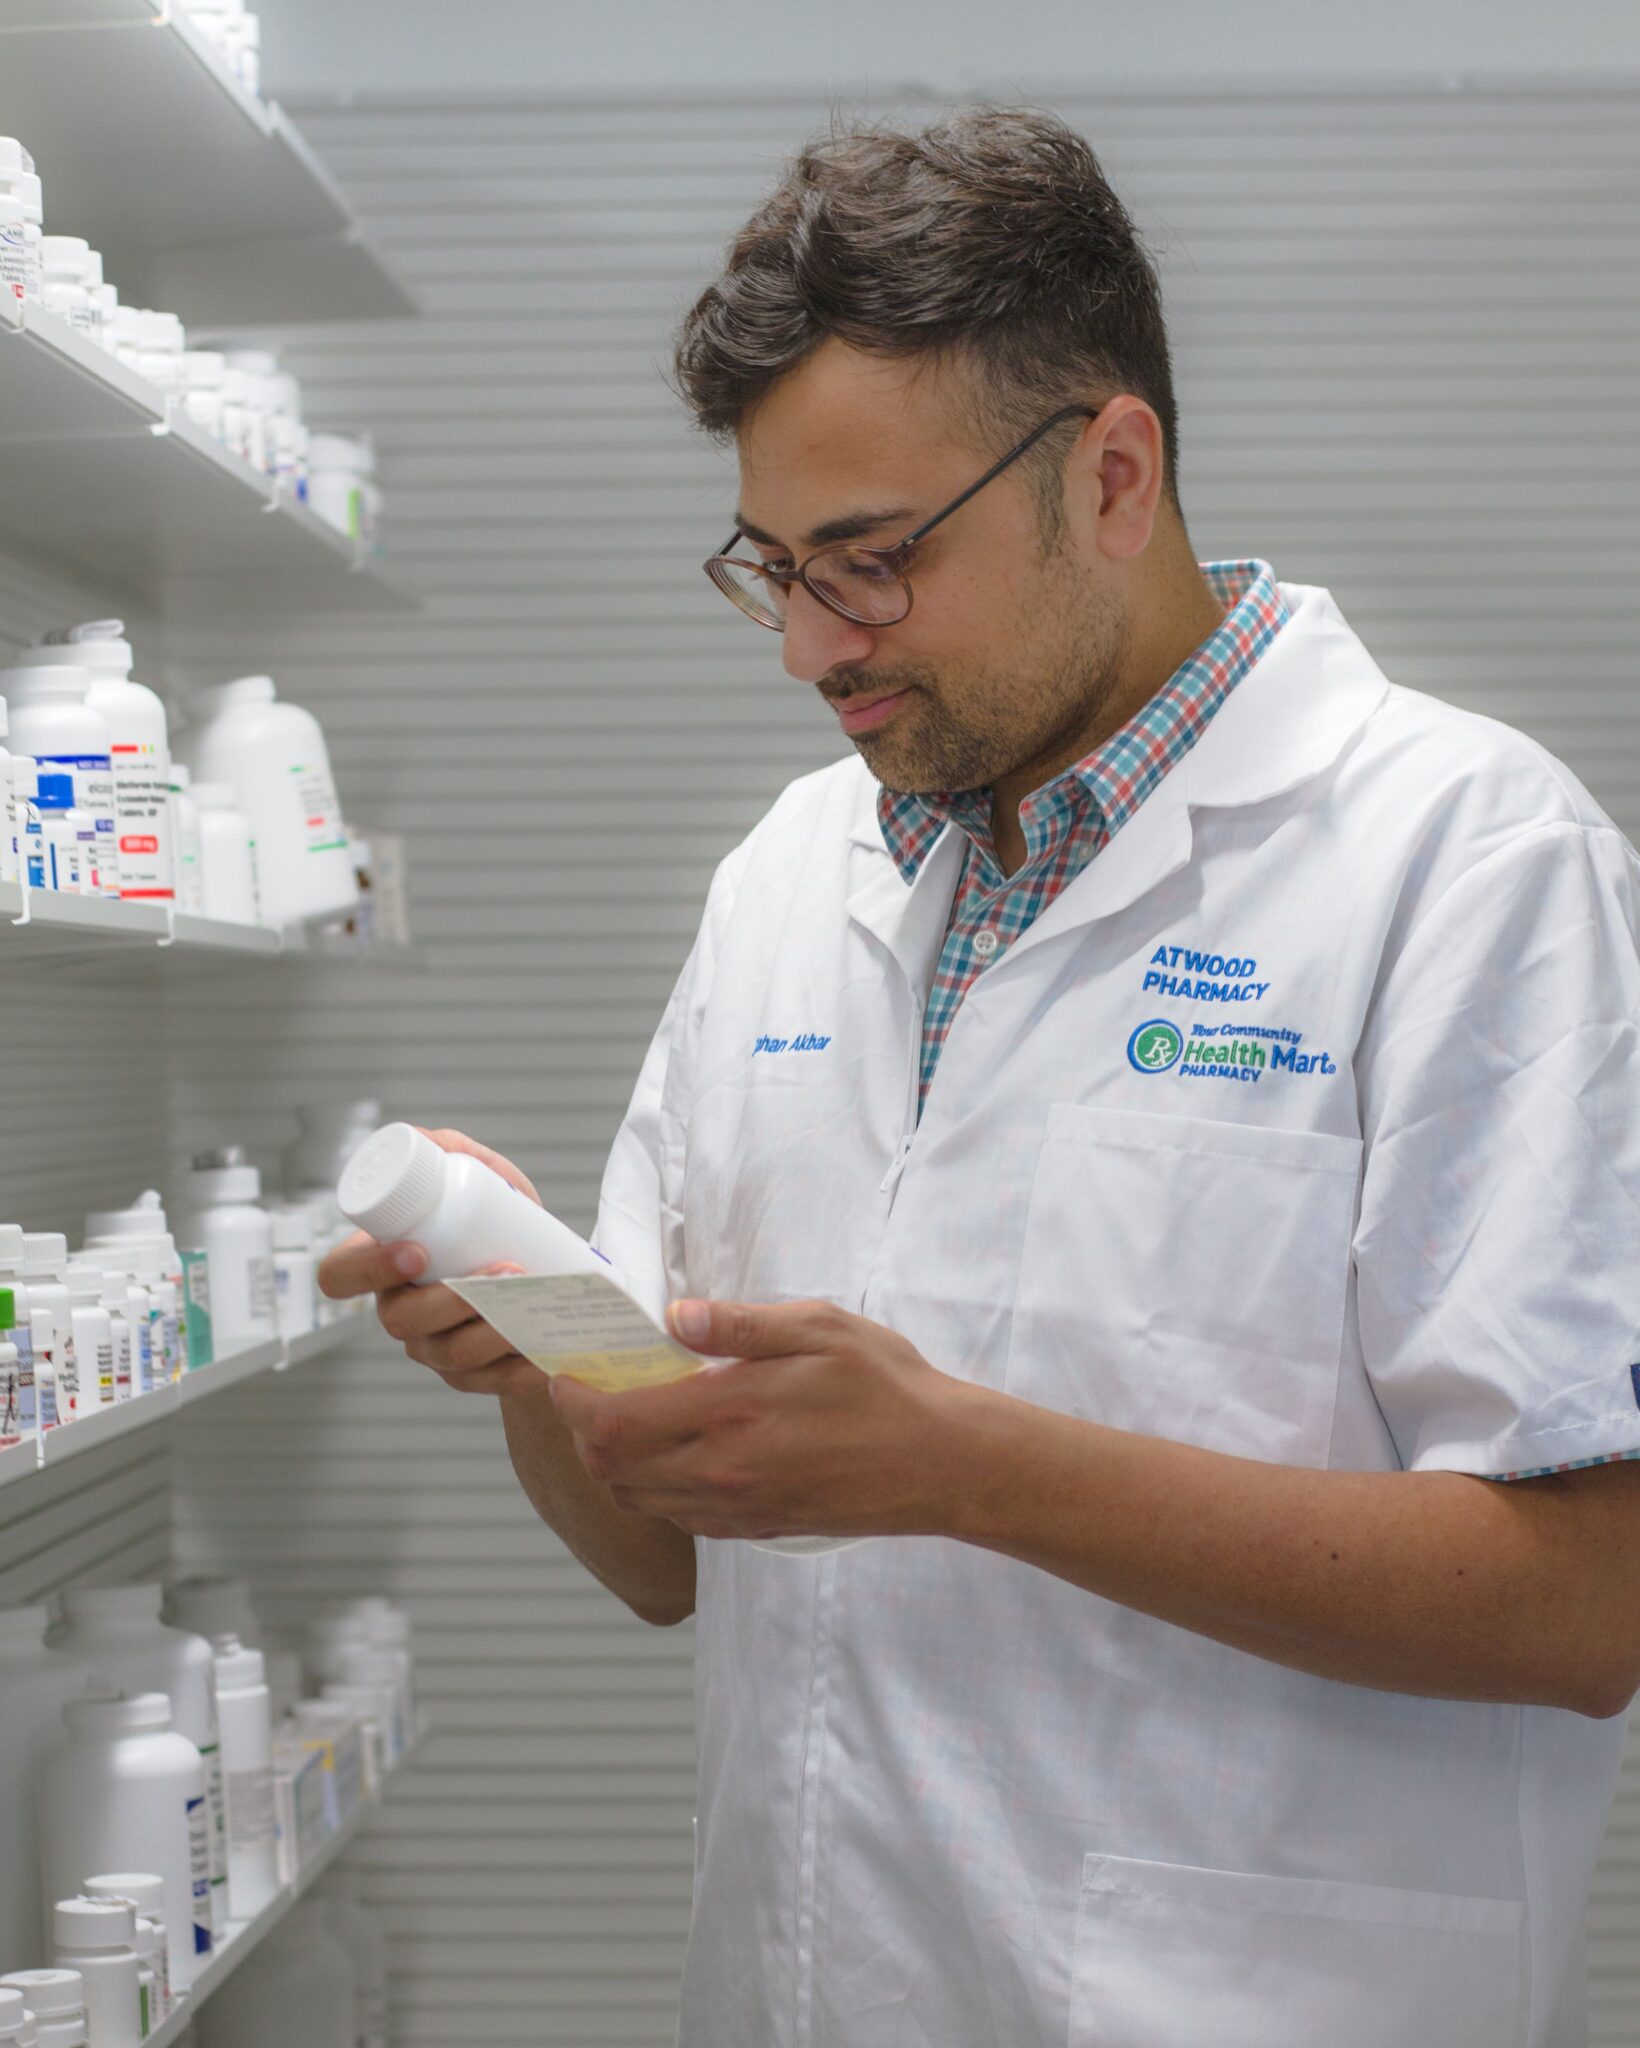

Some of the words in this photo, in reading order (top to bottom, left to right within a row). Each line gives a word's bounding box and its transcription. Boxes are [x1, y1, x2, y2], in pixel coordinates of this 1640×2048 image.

[1150, 945, 1257, 978] ATWOOD
[1142, 970, 1270, 1002] PHARMACY
[788, 1032, 831, 1052] Akbar
[1220, 1023, 1303, 1045] Community
[1184, 1040, 1265, 1068] Health
[1179, 1064, 1262, 1083] PHARMACY
